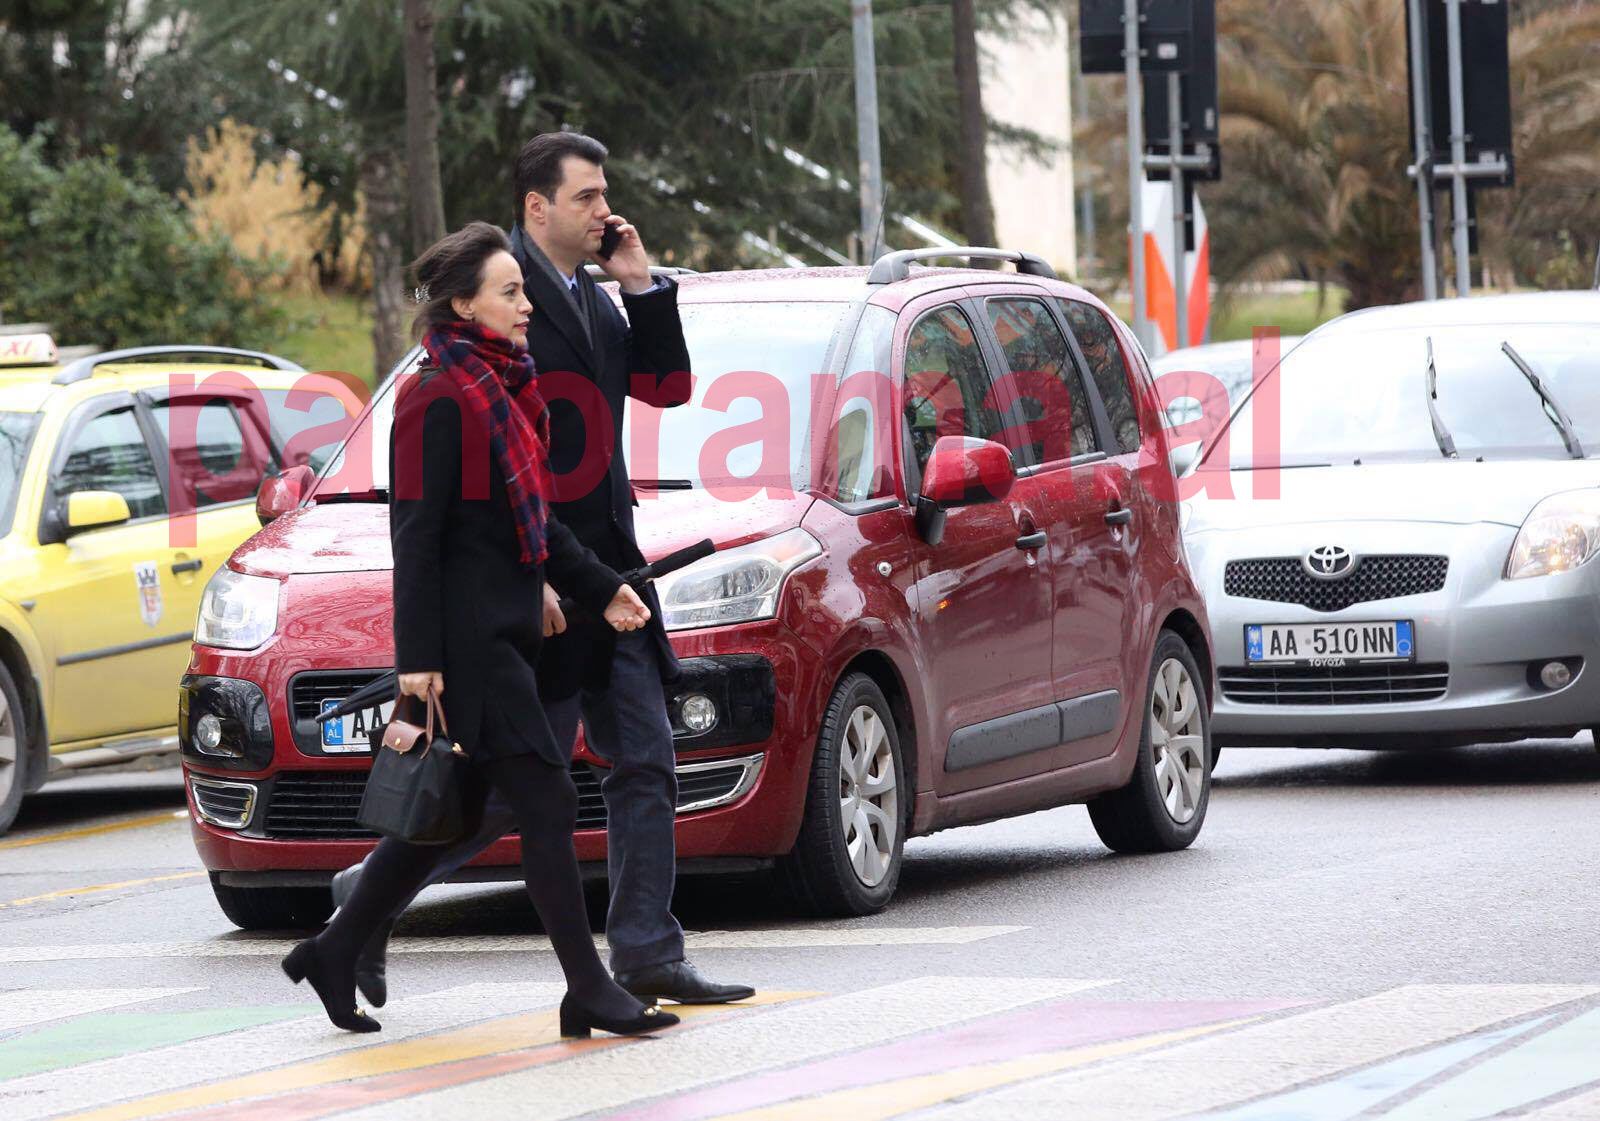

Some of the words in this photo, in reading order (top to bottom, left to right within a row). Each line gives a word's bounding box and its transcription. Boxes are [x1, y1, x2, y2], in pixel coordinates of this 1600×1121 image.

[1270, 629, 1298, 656] AA
[1308, 658, 1346, 667] TOYOTA
[351, 703, 384, 738] AA
[327, 728, 341, 739] AL
